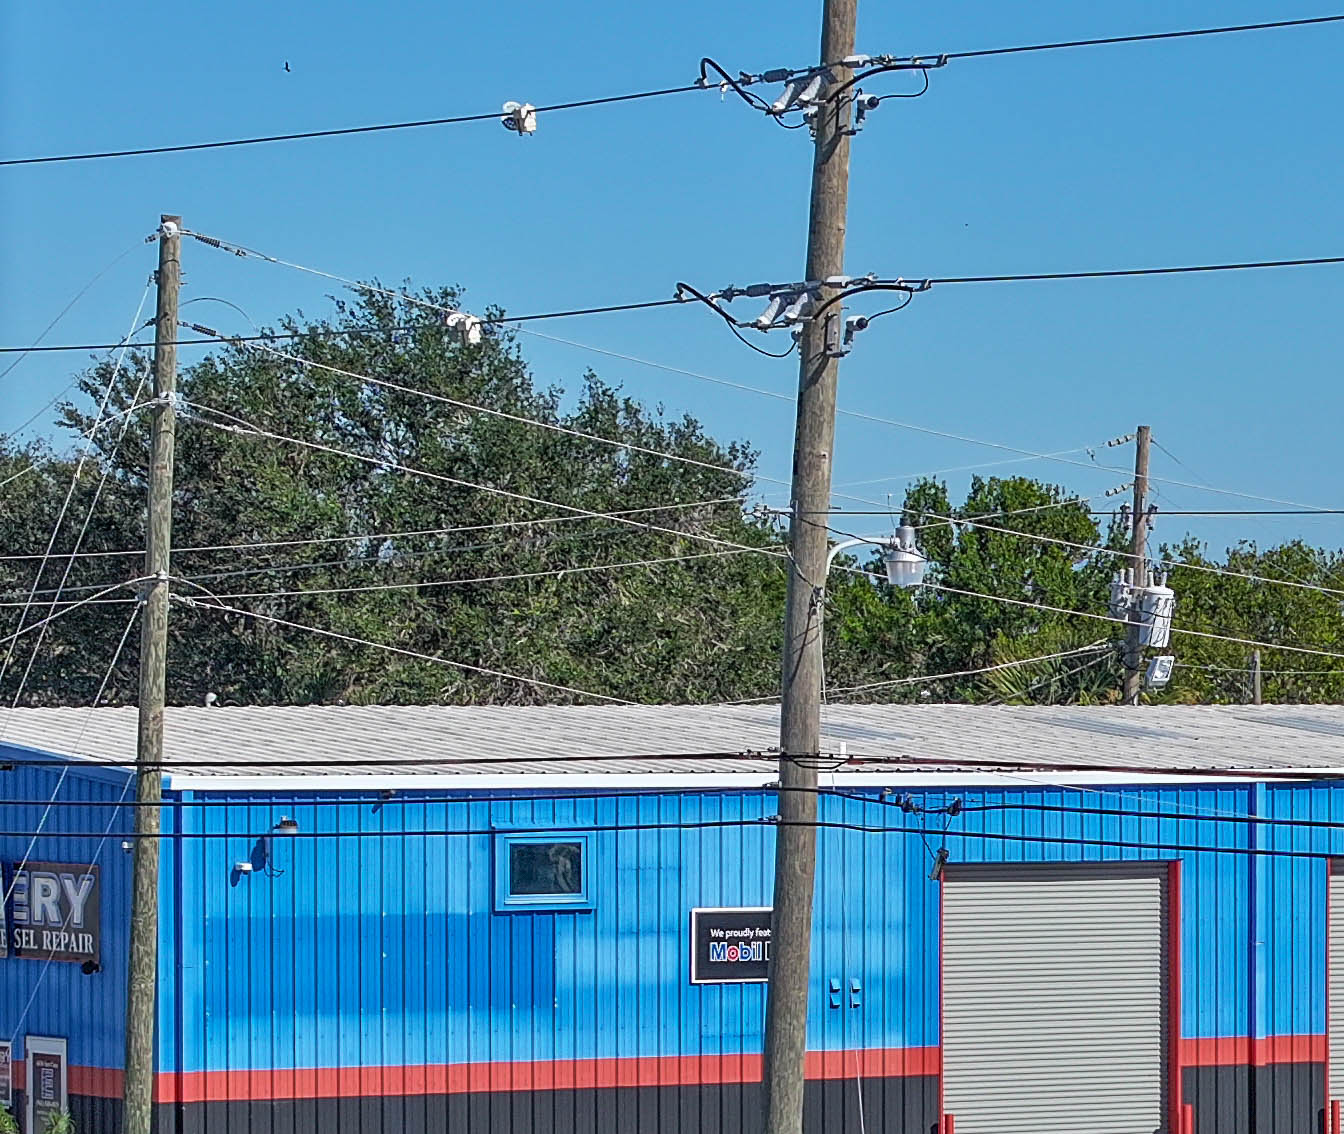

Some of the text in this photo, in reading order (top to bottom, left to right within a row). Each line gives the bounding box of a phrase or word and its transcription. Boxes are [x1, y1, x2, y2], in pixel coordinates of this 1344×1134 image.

[42, 930, 94, 954] REPAIR
[710, 927, 771, 939] We proudly feat
[709, 941, 762, 962] Mobil
